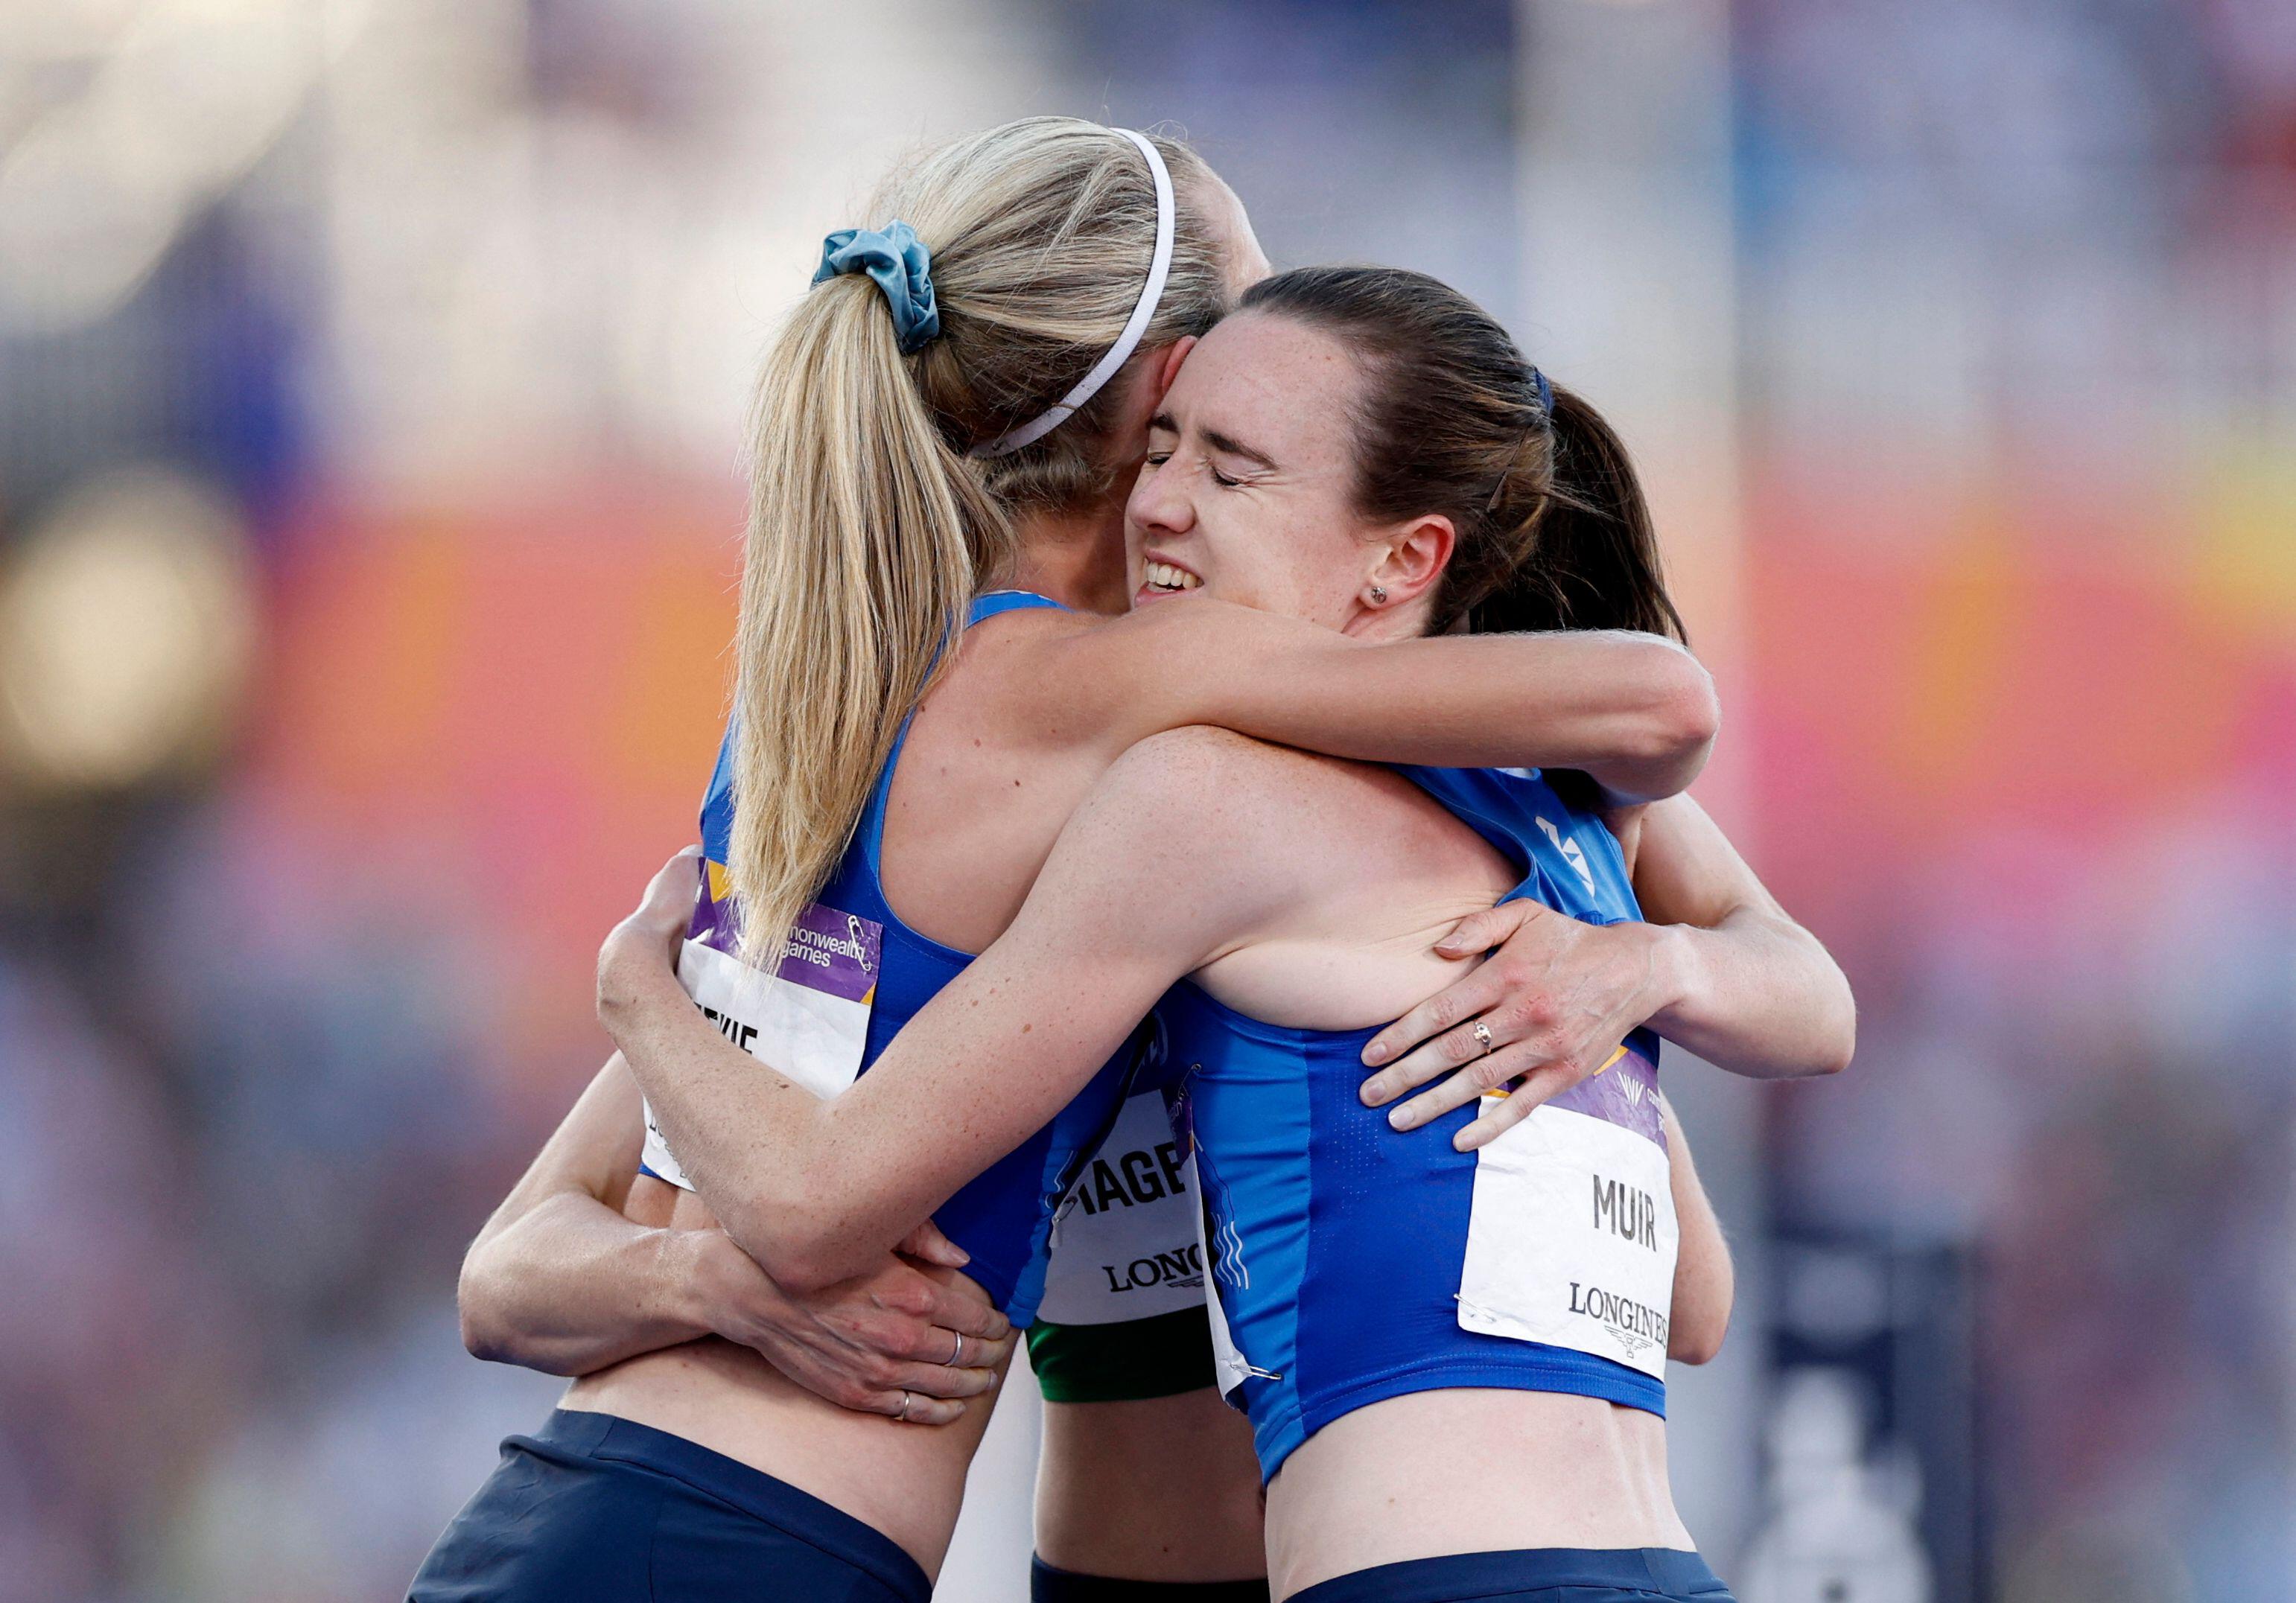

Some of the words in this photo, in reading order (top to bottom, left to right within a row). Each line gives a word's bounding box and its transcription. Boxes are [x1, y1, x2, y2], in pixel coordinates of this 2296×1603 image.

[781, 940, 831, 967] games
[1593, 1174, 1657, 1252] MUIR
[1568, 1281, 1667, 1349] LONGINES
